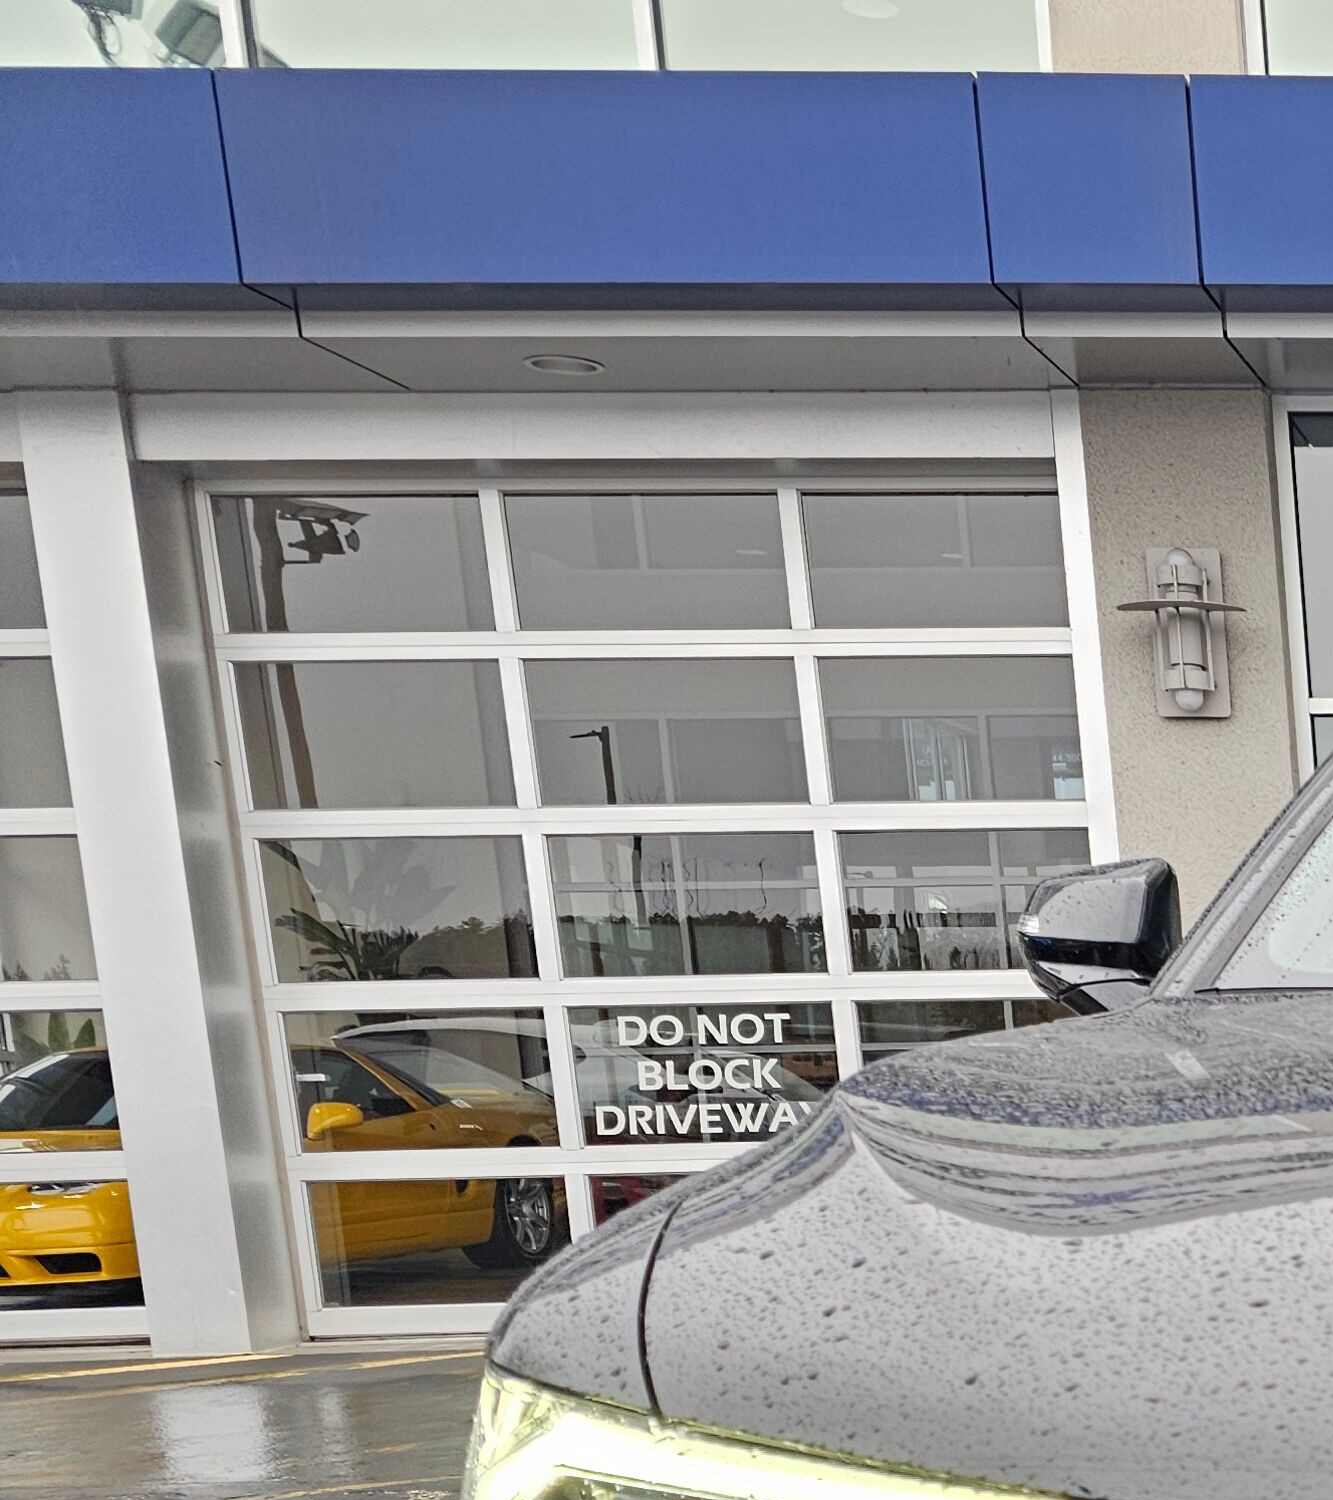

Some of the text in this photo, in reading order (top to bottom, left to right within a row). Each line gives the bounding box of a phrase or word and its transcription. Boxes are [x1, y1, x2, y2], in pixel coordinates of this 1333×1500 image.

[617, 1013, 790, 1046] DO NOT
[637, 1058, 782, 1091] BLOCK
